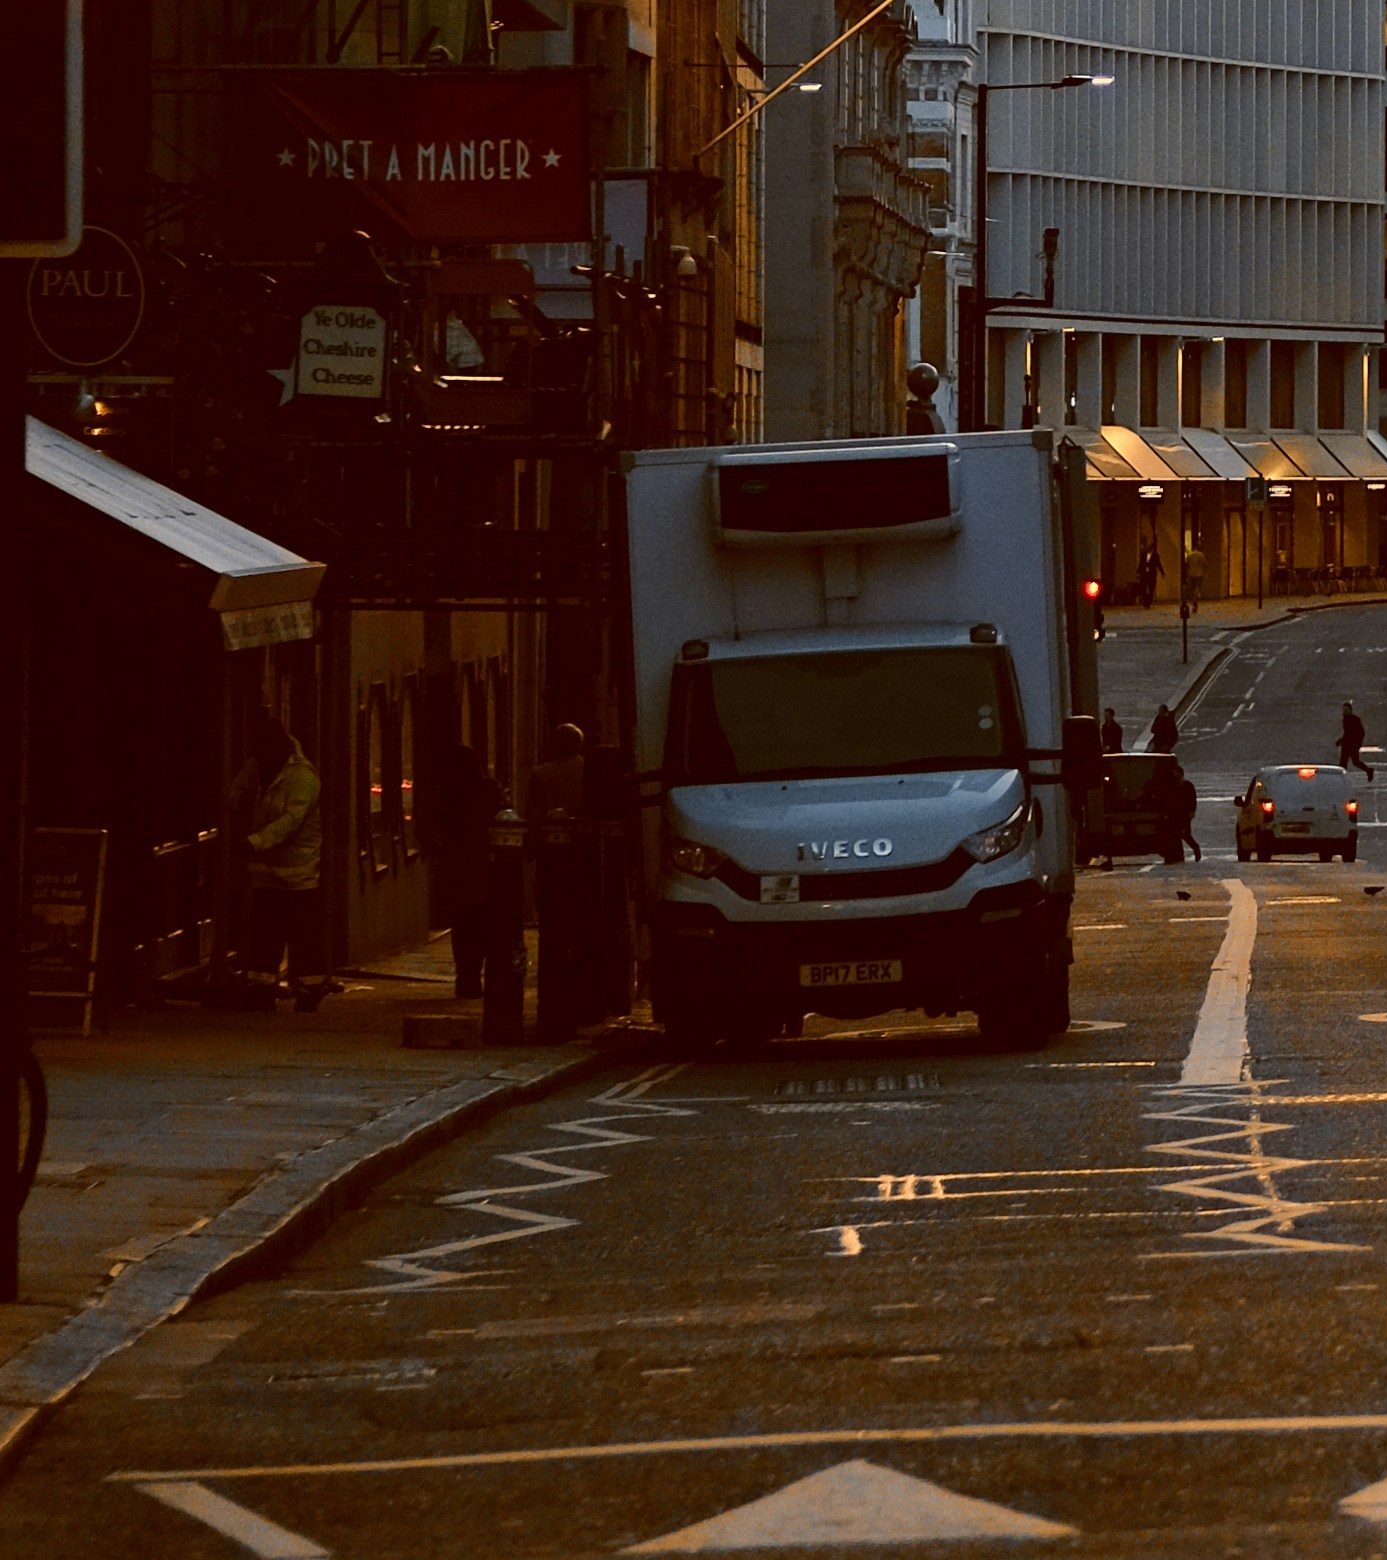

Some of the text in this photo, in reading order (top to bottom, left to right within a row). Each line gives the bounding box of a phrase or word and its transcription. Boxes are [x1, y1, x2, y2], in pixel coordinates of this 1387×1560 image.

[307, 137, 532, 182] PRET A MANGER
[39, 269, 134, 298] PAUL
[314, 310, 376, 329] Ye Olde
[303, 338, 376, 358] Cheshire
[312, 367, 375, 386] Cheese
[797, 838, 893, 861] IVECO
[810, 962, 892, 984] BP17 ERX
